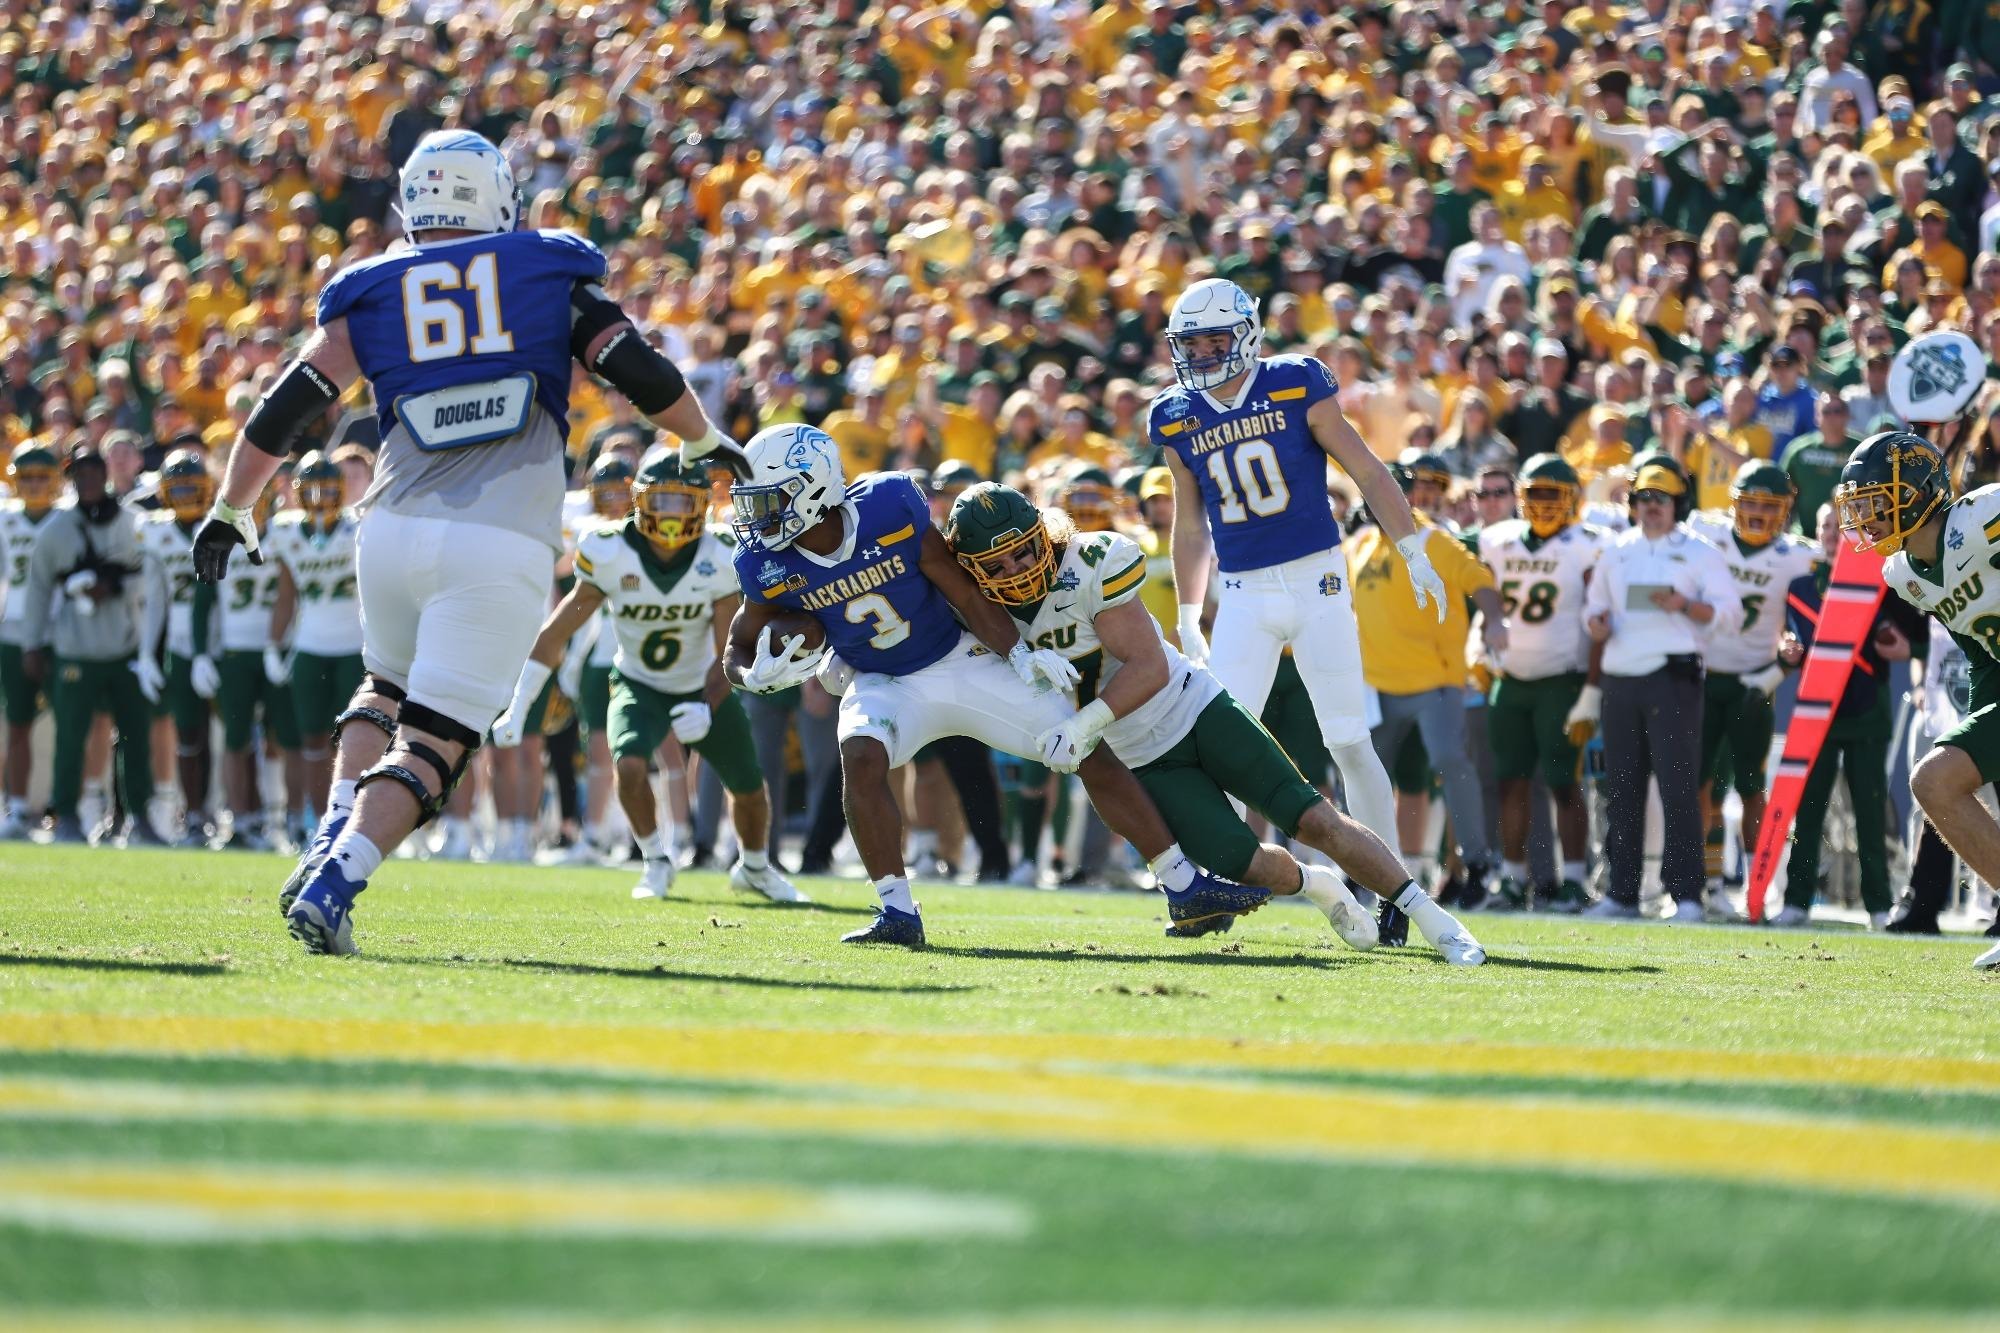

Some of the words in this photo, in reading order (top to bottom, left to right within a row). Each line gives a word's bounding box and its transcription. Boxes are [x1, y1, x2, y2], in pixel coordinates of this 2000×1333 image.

[411, 214, 435, 227] LAST
[438, 214, 467, 227] PLAY
[401, 252, 515, 363] 61
[307, 369, 333, 399] Mueller
[434, 397, 506, 429] DOUGLAS
[1190, 410, 1287, 456] JACKRABBITS
[1207, 438, 1291, 524] 10
[800, 554, 906, 611] JACKRABBITS
[1727, 565, 1773, 588] DSU
[618, 602, 705, 622] NDSU
[844, 592, 911, 650] 3
[1500, 580, 1561, 624] 58
[640, 627, 683, 672] 6
